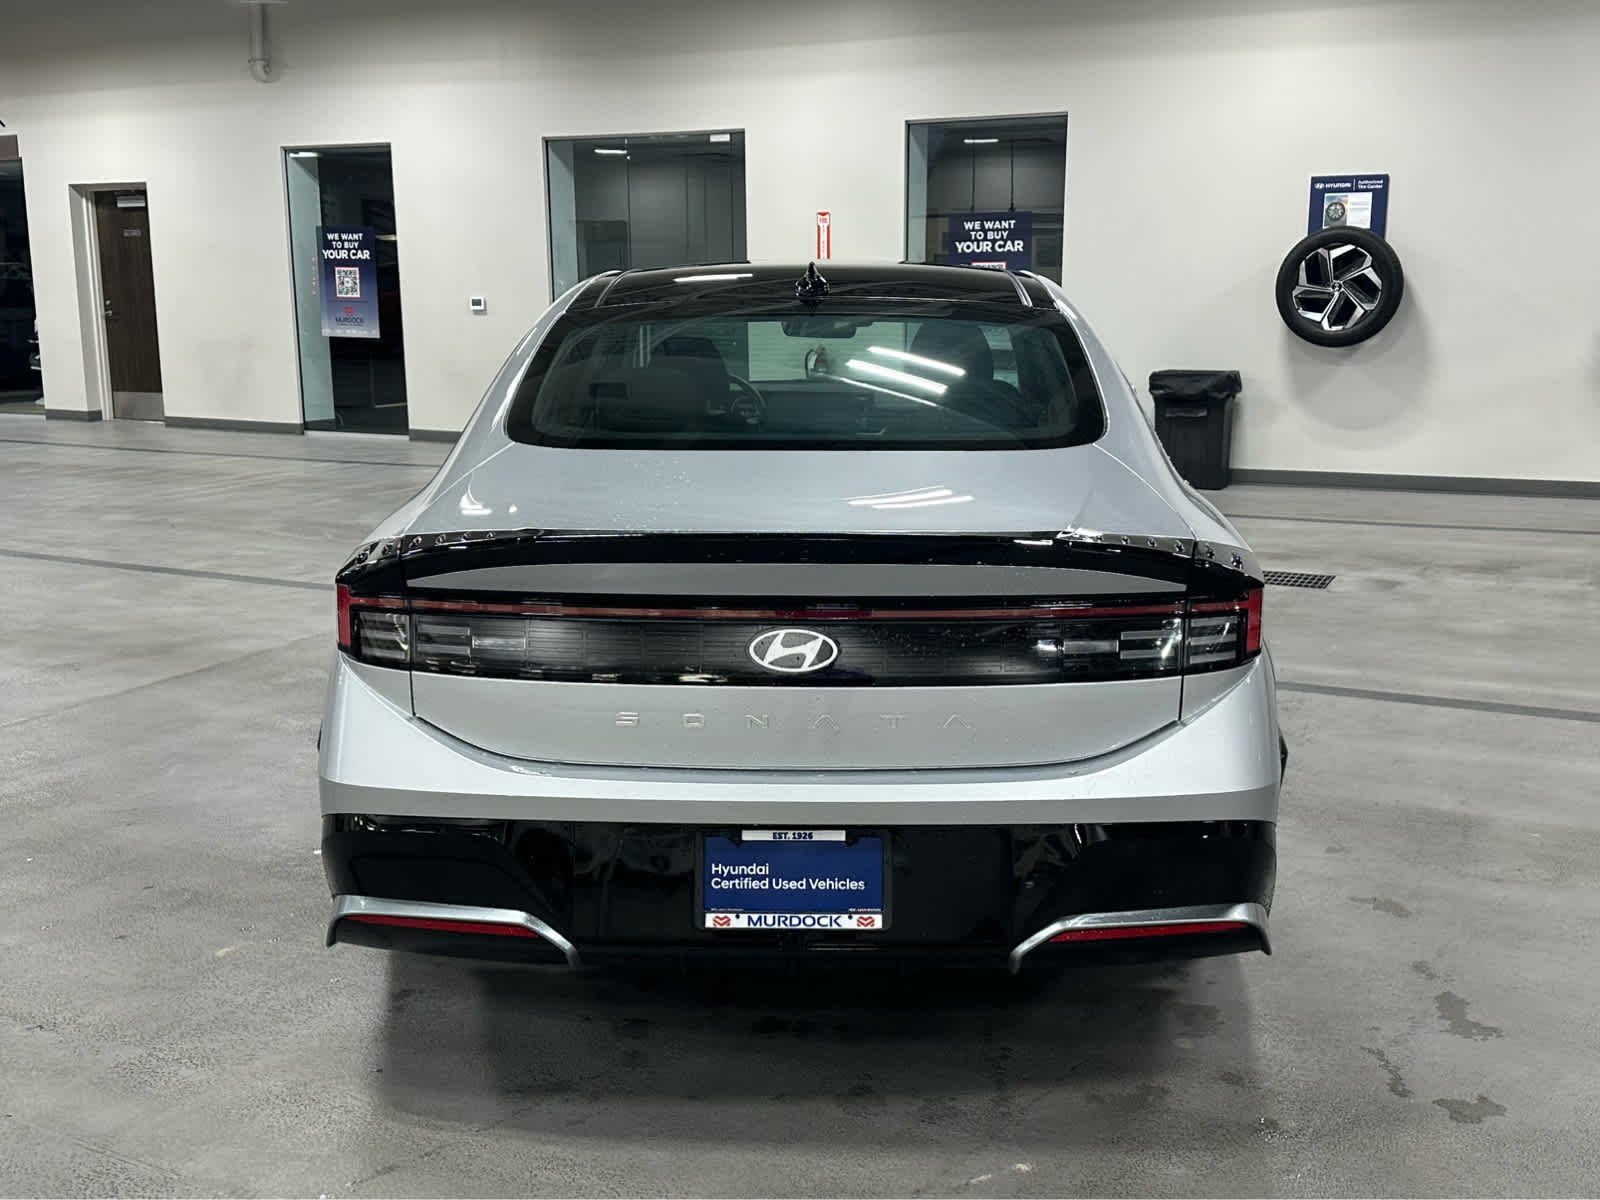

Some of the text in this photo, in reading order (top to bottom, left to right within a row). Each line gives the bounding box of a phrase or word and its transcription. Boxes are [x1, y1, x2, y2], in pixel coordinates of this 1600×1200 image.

[963, 220, 1016, 230] WE WANT
[326, 233, 363, 241] WE WANT
[970, 230, 1008, 240] TO BUY
[332, 241, 359, 249] TO BUY
[955, 240, 1024, 253] YOUR CAR
[322, 249, 370, 260] YOUR CAR
[615, 711, 971, 729] SONATA
[772, 832, 813, 840] EST. 1926
[711, 863, 769, 876] Hyundai
[711, 878, 865, 890] Certified Used Vehicles
[747, 915, 842, 928] MURDOCK
